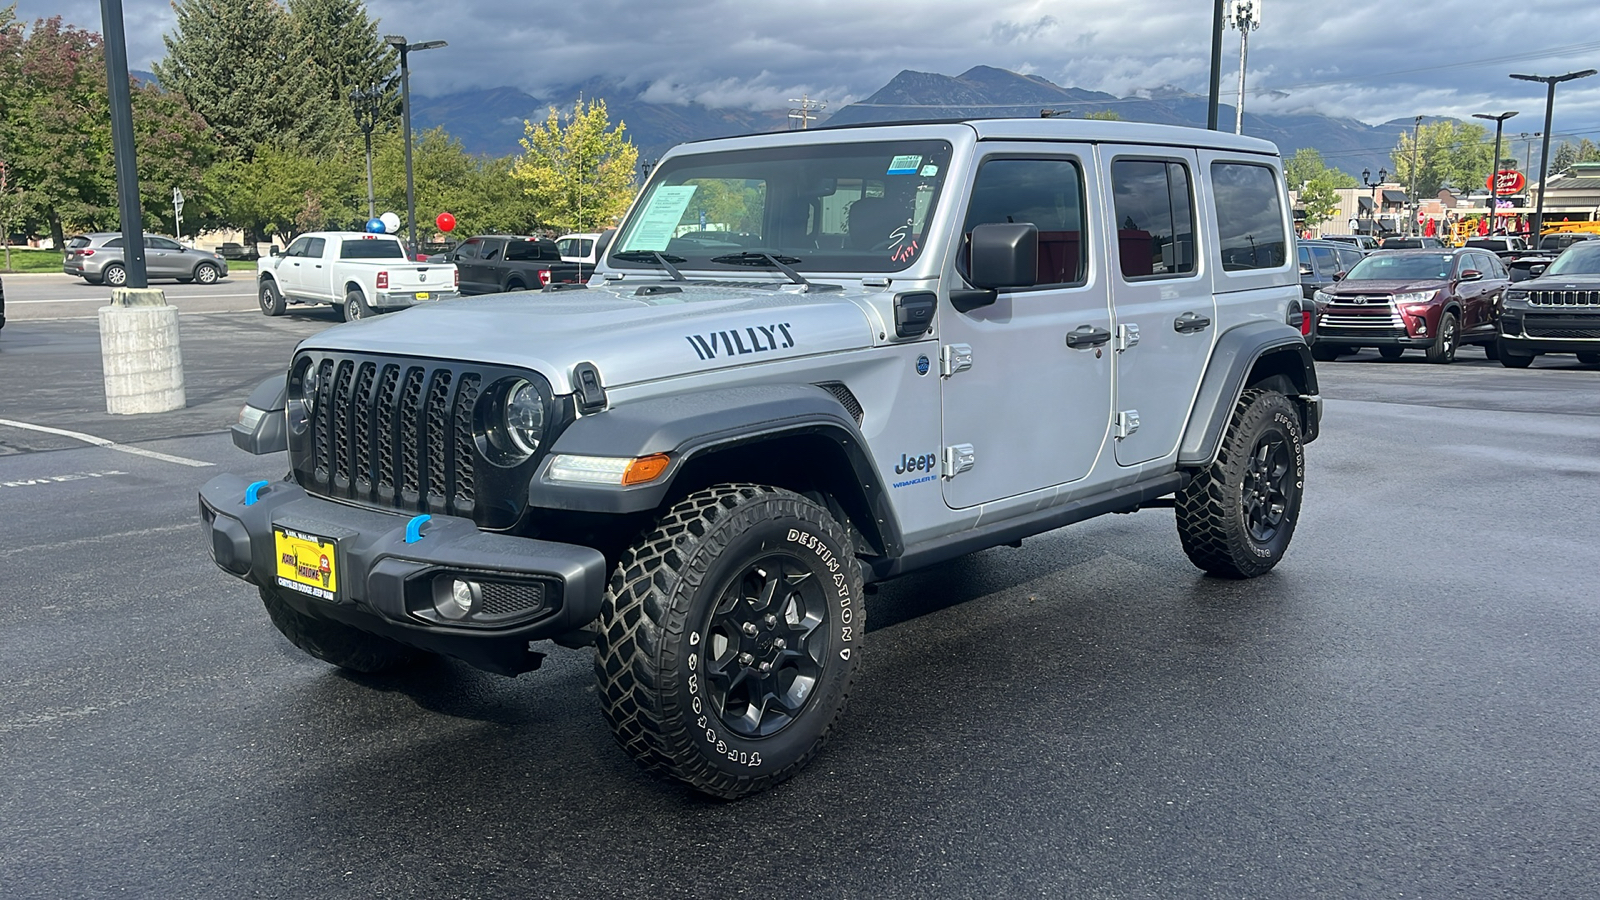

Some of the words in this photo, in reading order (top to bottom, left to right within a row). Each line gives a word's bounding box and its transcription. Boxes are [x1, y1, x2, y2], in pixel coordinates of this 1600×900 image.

[685, 322, 795, 361] WILLYS
[894, 453, 936, 475] Jeep
[892, 476, 931, 489] WRANGLER
[282, 552, 296, 567] KARL
[321, 558, 328, 568] 32
[298, 565, 320, 581] MALONE
[787, 528, 853, 642] DESTINATION
